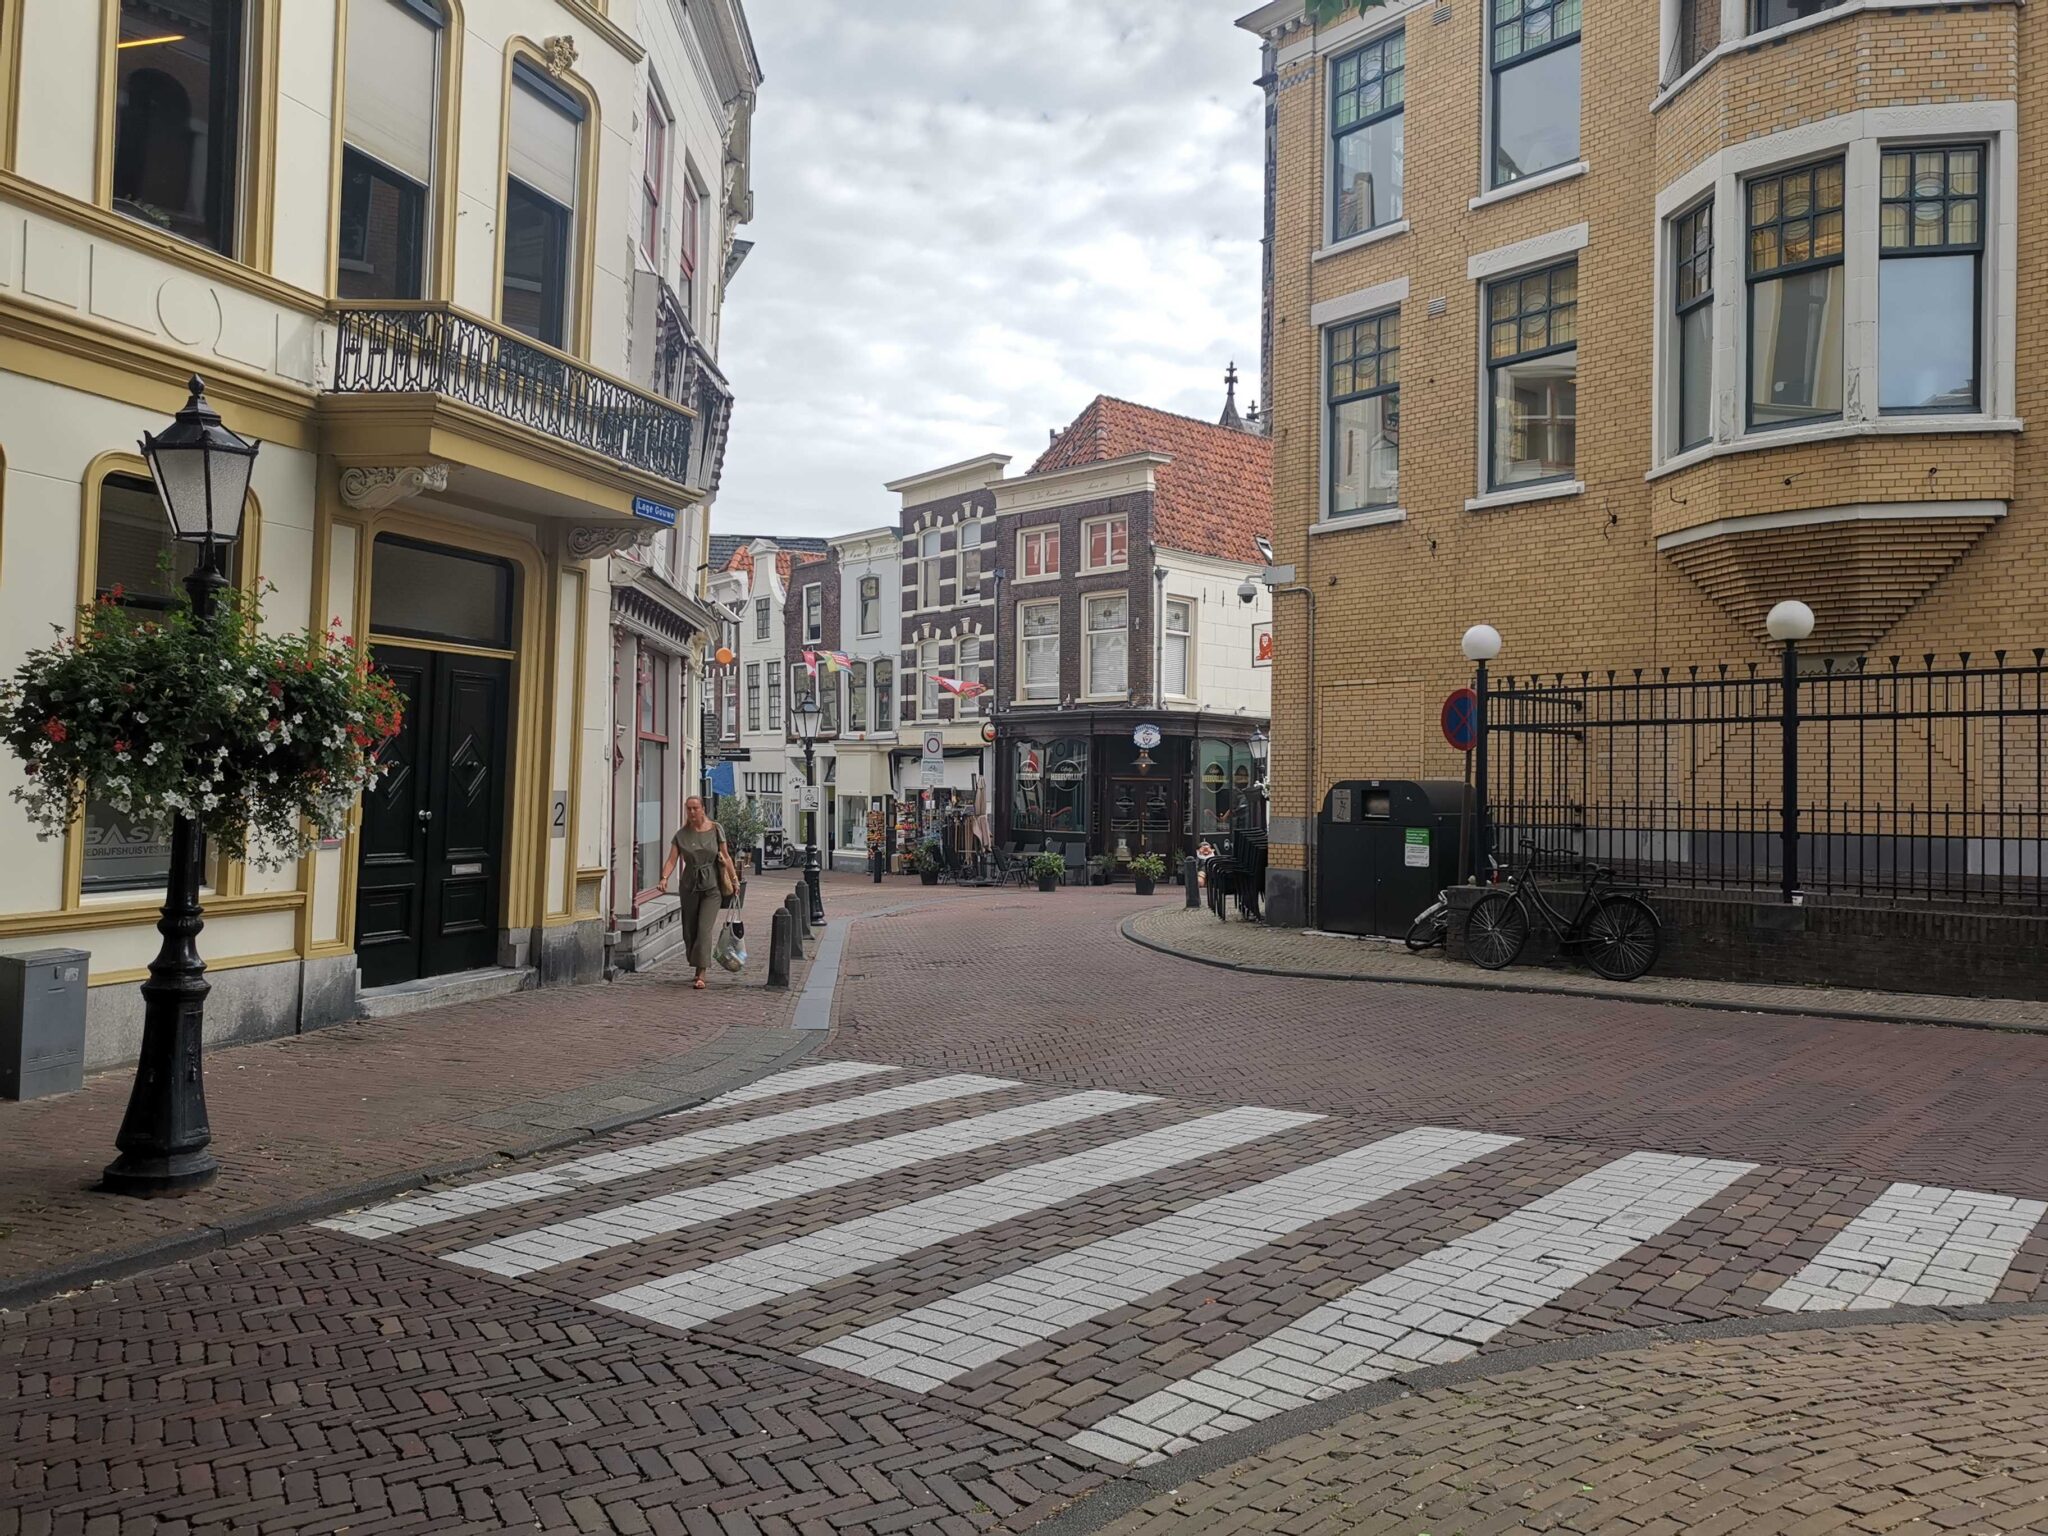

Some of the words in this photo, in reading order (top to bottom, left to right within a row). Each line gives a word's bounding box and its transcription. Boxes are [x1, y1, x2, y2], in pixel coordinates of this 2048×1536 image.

[637, 500, 653, 514] Lage
[654, 505, 674, 519] Gouwe
[554, 802, 565, 826] 2
